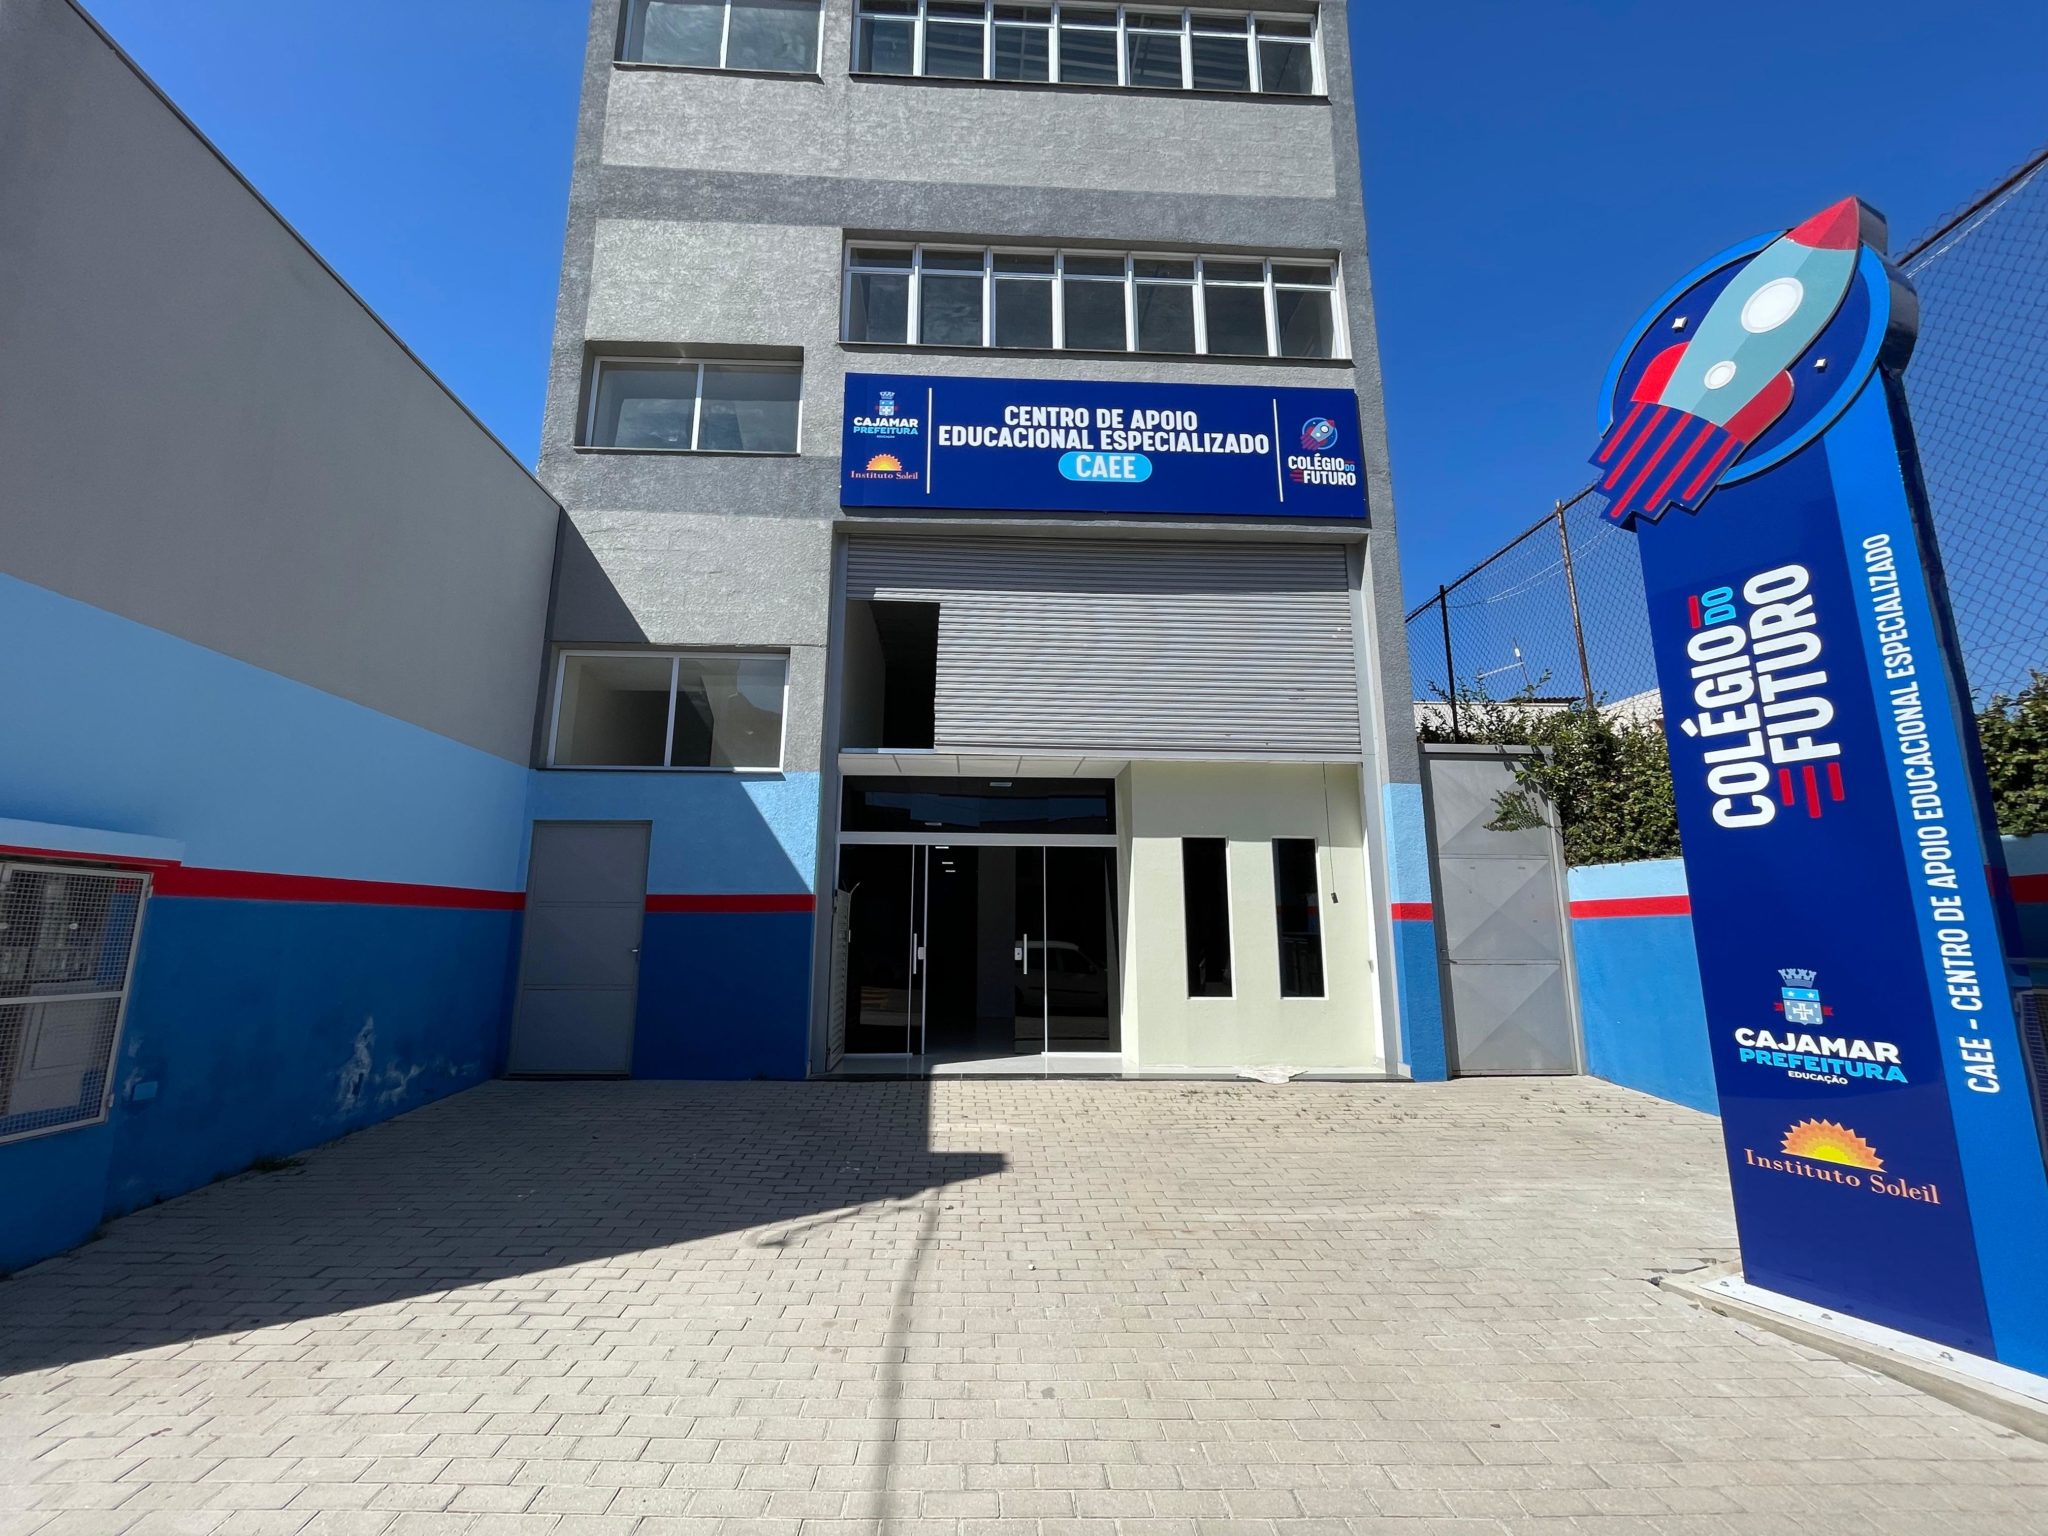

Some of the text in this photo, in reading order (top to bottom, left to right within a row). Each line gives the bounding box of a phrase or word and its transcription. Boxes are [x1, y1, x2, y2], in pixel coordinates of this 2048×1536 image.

[853, 416, 919, 428] CAJAMAR
[853, 426, 919, 435] PREFEITURA
[1004, 405, 1198, 431] CENTRO DE APOIO
[938, 425, 1270, 454] EDUCACIONAL ESPECIALIZADO
[851, 470, 919, 480] Instituto Soleil
[1076, 454, 1136, 479] CAEE
[1287, 453, 1356, 472] COLÉGIO DO
[1303, 470, 1357, 486] FUTURO
[1862, 533, 1915, 680] ESPECIALIZADO
[1743, 564, 1841, 764] FUTURO
[1680, 586, 1776, 829] COLÉGIO DO
[1890, 681, 1944, 820] EDUCACIONAL
[1917, 825, 1959, 889] APOIO
[1930, 895, 1965, 922] DE
[1937, 928, 1983, 1012] CENTRO
[1734, 1027, 1901, 1064] CAJAMAR
[1739, 1047, 1909, 1084] PREFEITURA
[1788, 1070, 1848, 1085] EDUCAÇÃO
[1959, 1036, 2000, 1094] CAEE
[1744, 1148, 1941, 1205] Instituto Soleil
